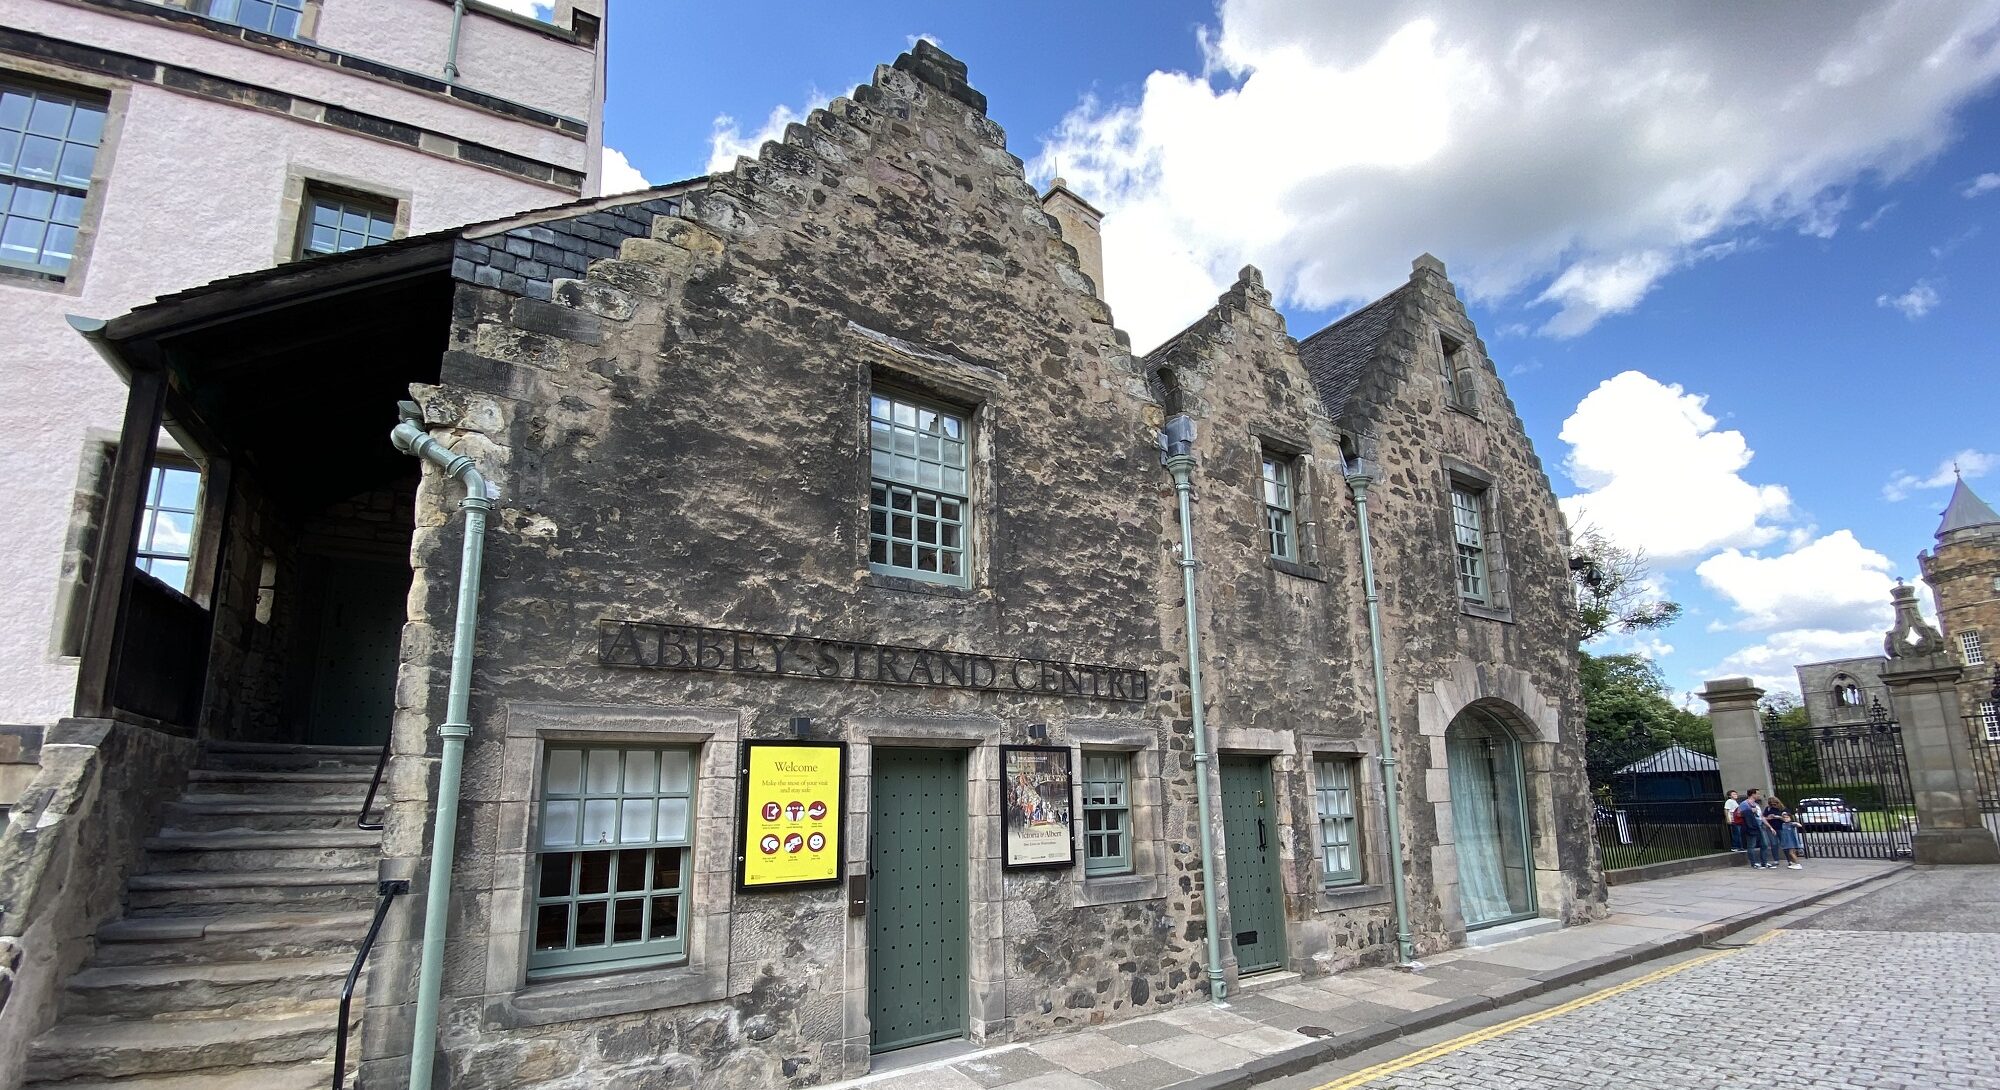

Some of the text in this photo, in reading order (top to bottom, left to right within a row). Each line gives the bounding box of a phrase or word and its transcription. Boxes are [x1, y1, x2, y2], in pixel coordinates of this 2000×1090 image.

[602, 621, 1145, 701] ABBEY STRAND CENTRE
[774, 761, 819, 773] Welcome
[762, 779, 777, 787] Make
[1017, 831, 1040, 839] Victoria
[1044, 830, 1062, 838] Albert
